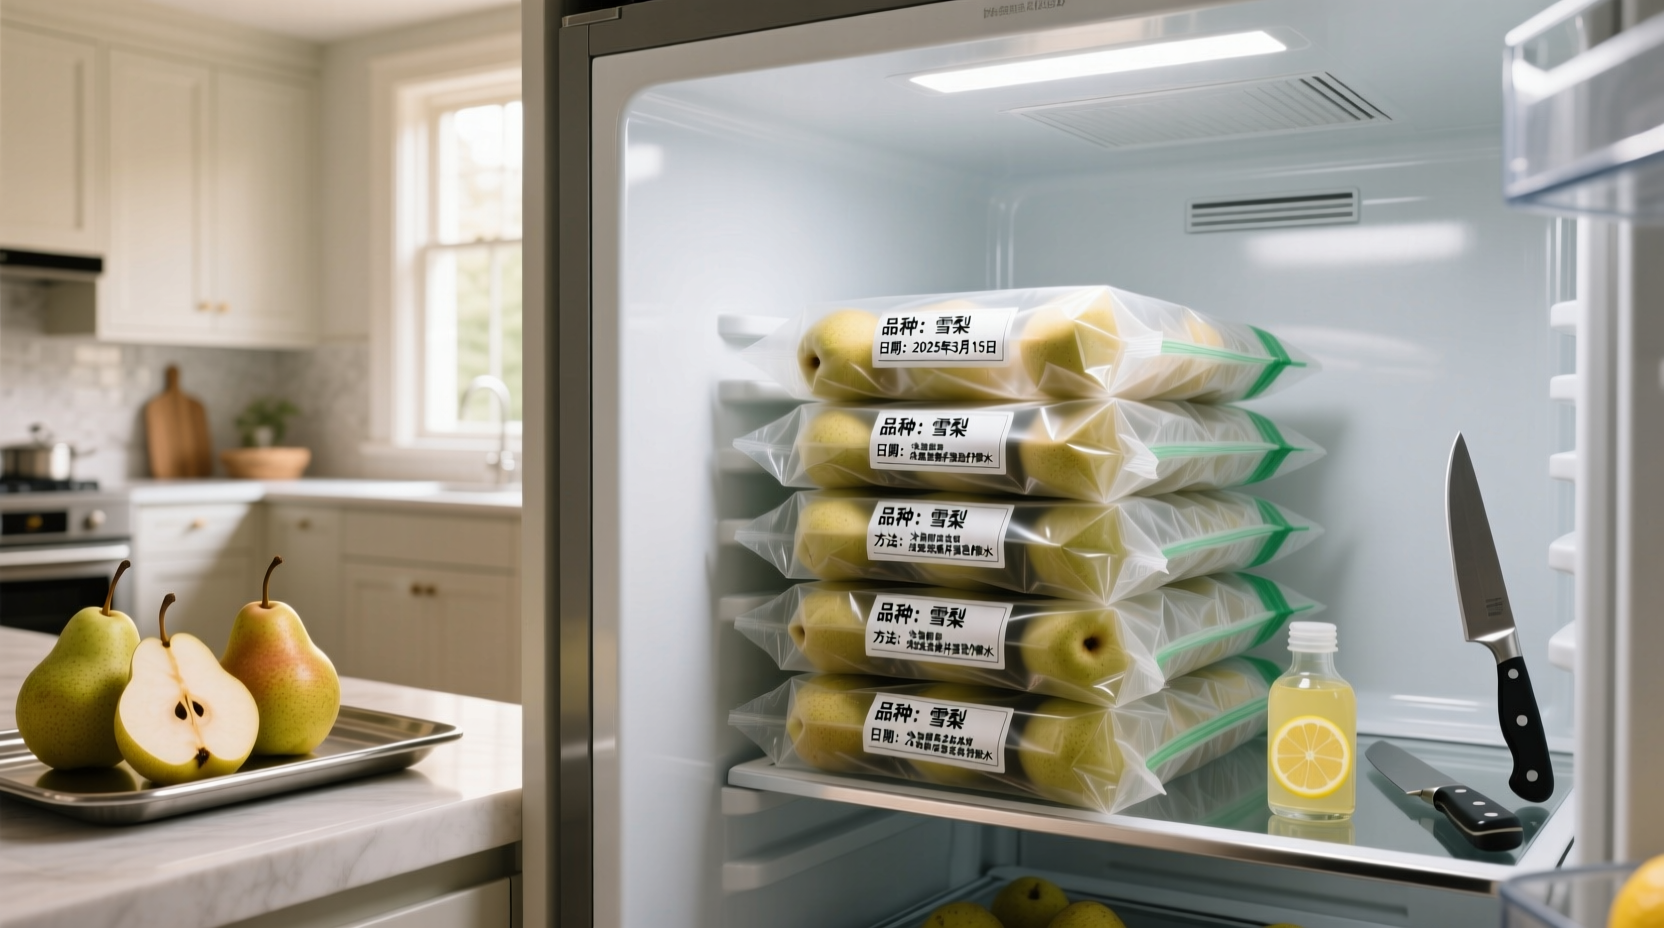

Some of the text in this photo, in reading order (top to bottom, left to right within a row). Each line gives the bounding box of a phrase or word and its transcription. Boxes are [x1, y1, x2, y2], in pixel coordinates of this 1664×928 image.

[882, 315, 972, 336] 品种：雪梨
[879, 417, 969, 438] 品种：雪梨
[878, 506, 968, 529] 品种：雪梨
[877, 602, 967, 629] 品种：雪梨
[875, 701, 967, 729] 品种：雪梨
